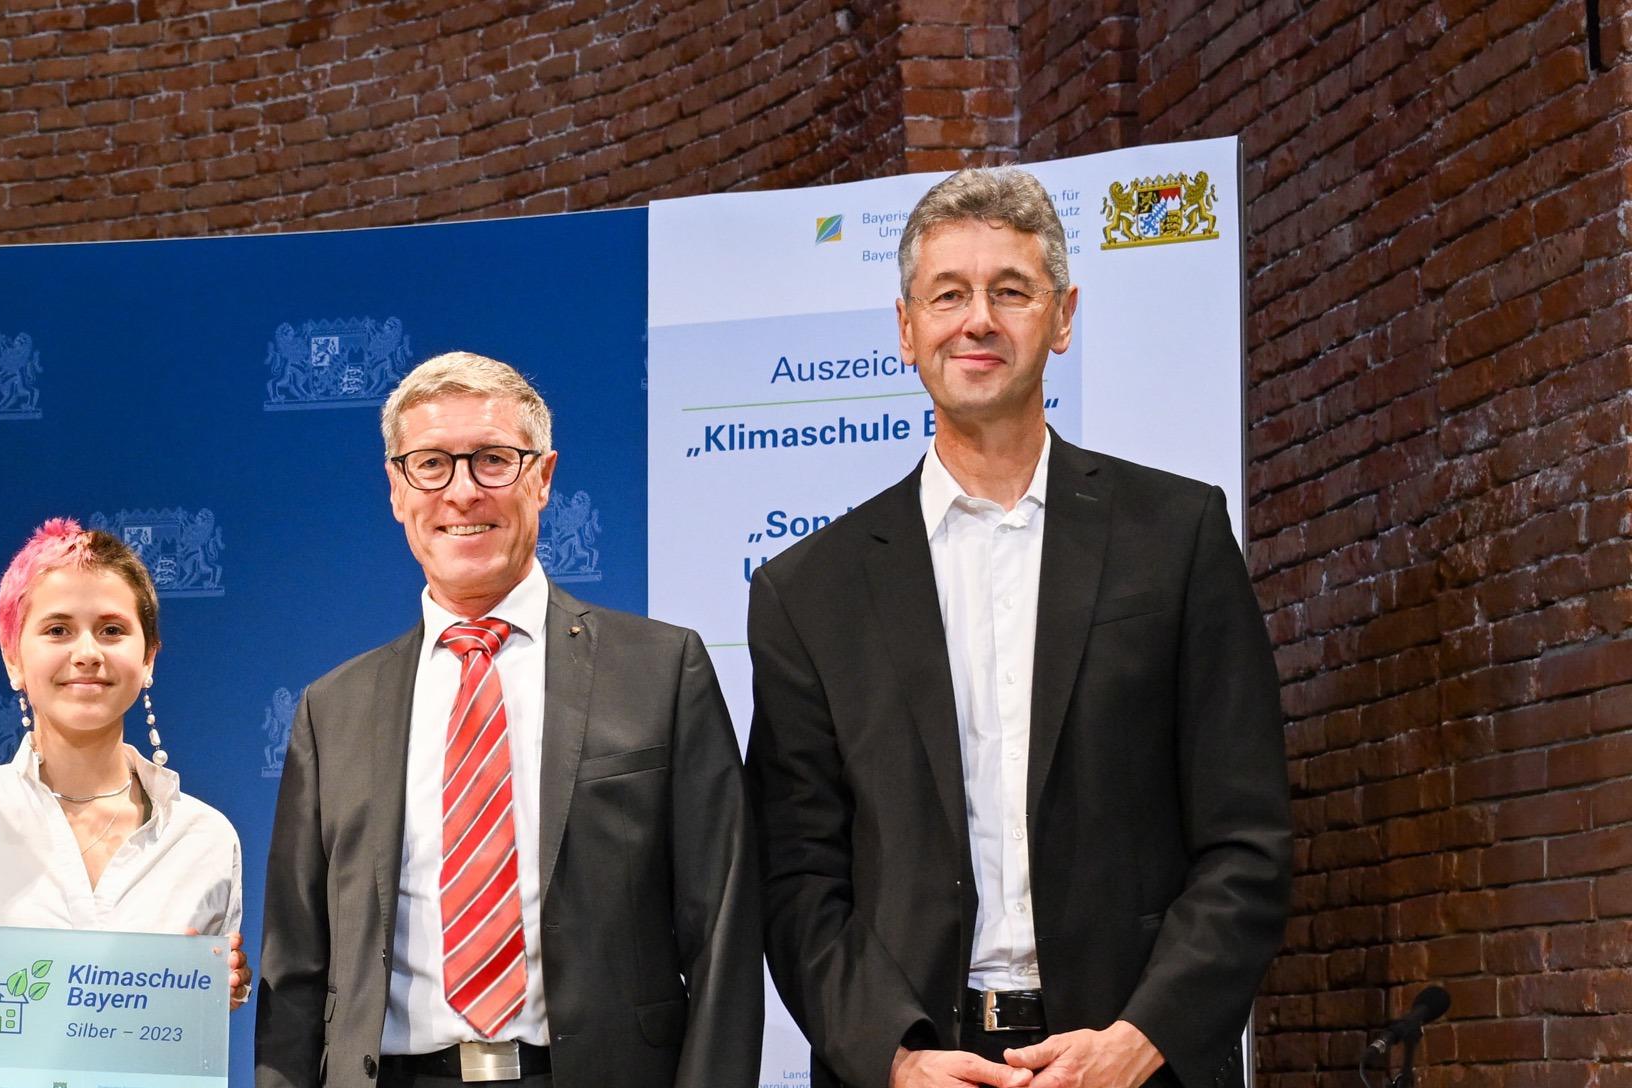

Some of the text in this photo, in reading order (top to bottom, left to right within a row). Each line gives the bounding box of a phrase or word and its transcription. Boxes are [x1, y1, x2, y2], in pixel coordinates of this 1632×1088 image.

[862, 211, 909, 225] Bayeris
[1062, 189, 1081, 201] für
[862, 249, 899, 263] Bayer
[770, 350, 918, 384] Auszeic
[67, 963, 212, 990] Klimaschule
[66, 986, 148, 1013] Bayern
[65, 1022, 118, 1039] Silber
[138, 1025, 184, 1042] 2023
